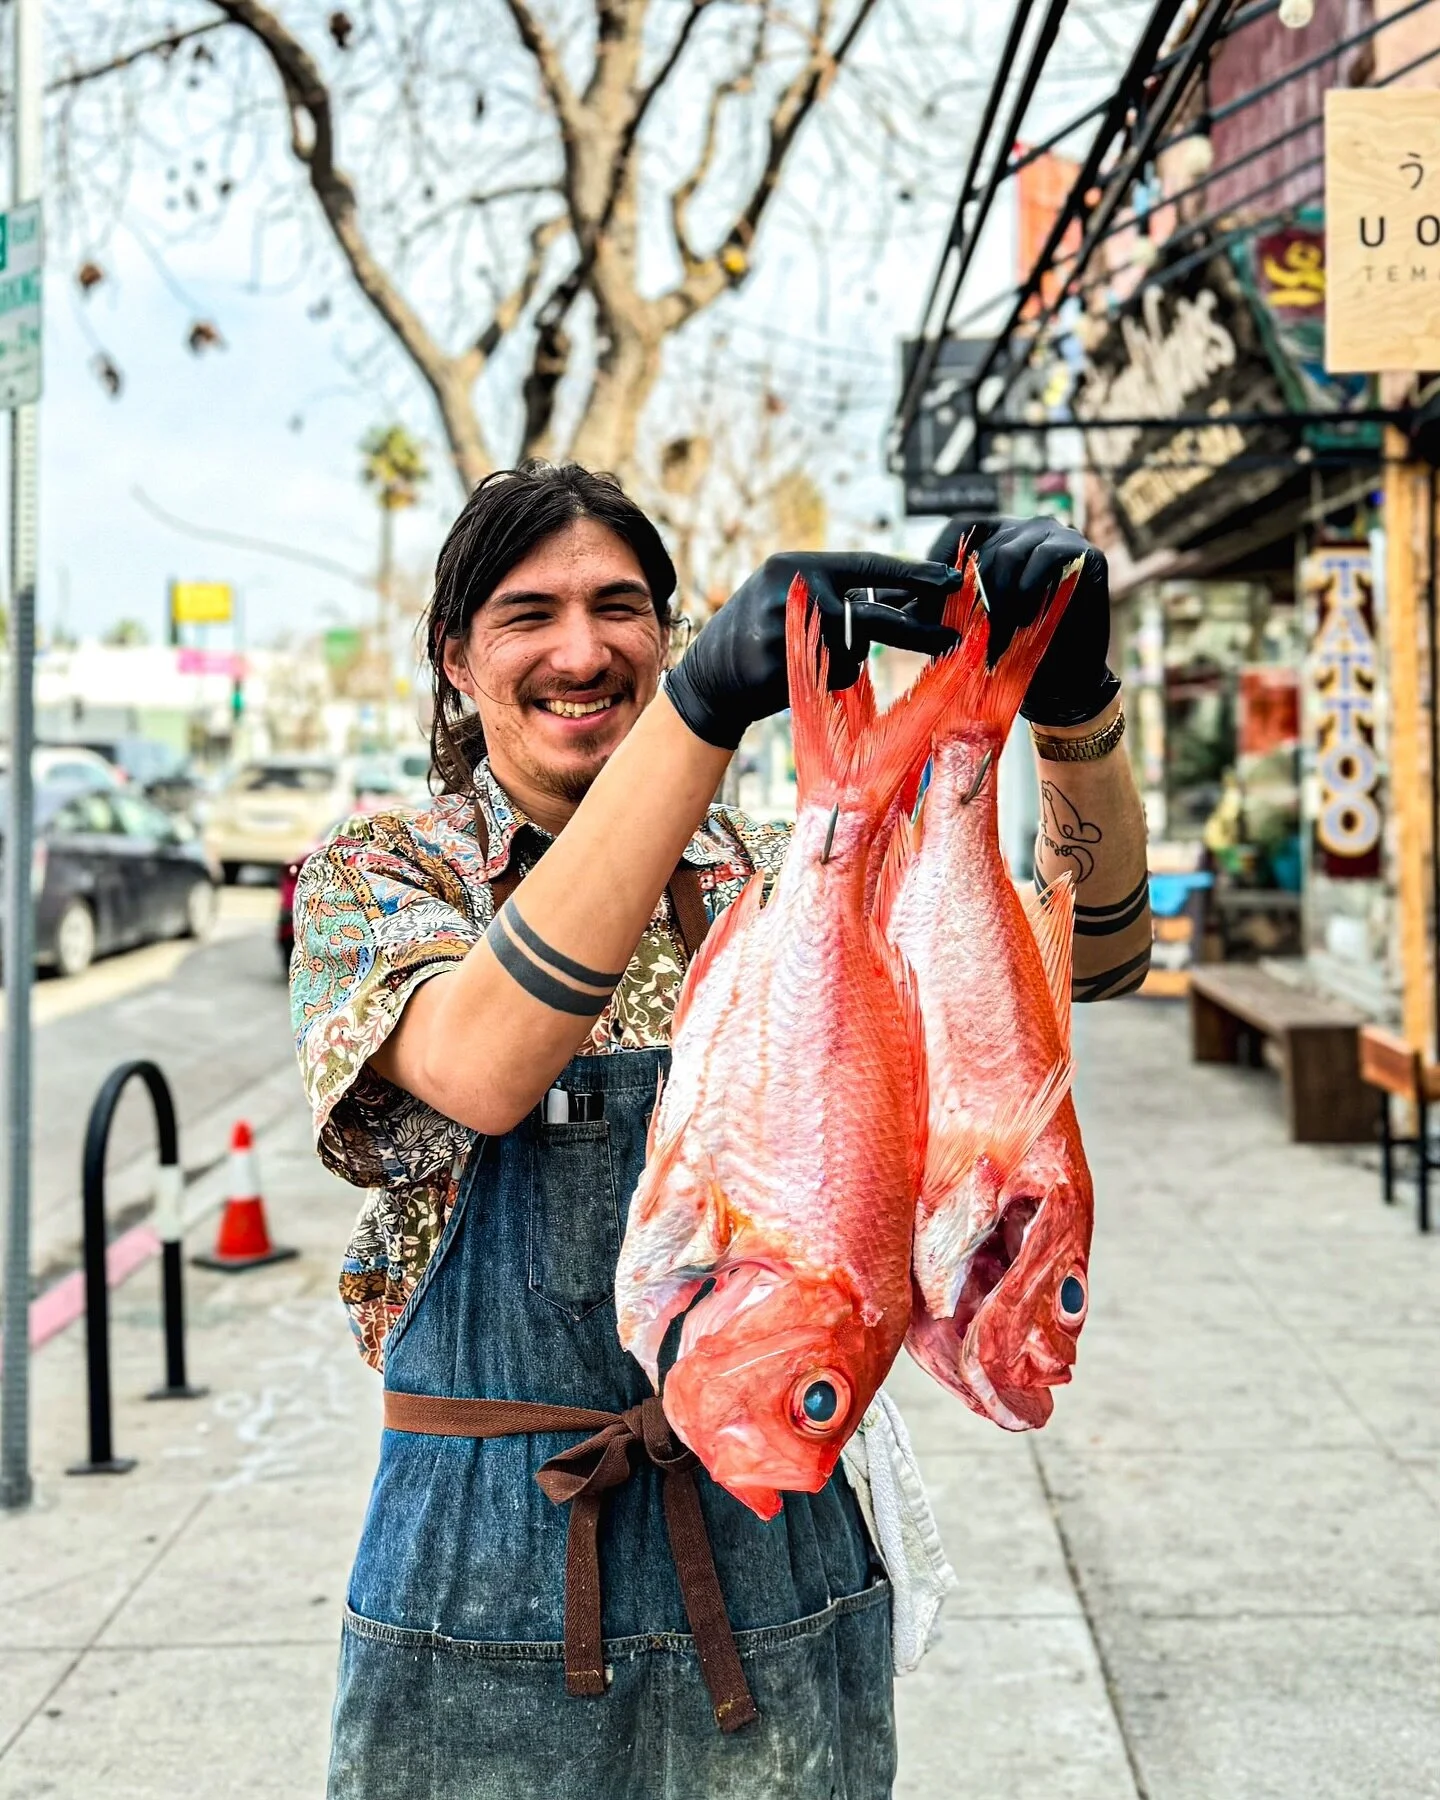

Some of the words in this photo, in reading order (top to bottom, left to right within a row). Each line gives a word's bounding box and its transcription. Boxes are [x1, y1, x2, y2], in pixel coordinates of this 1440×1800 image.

[1399, 152, 1424, 190] う
[1363, 265, 1440, 282] TEM
[1308, 550, 1380, 856] TATTOO
